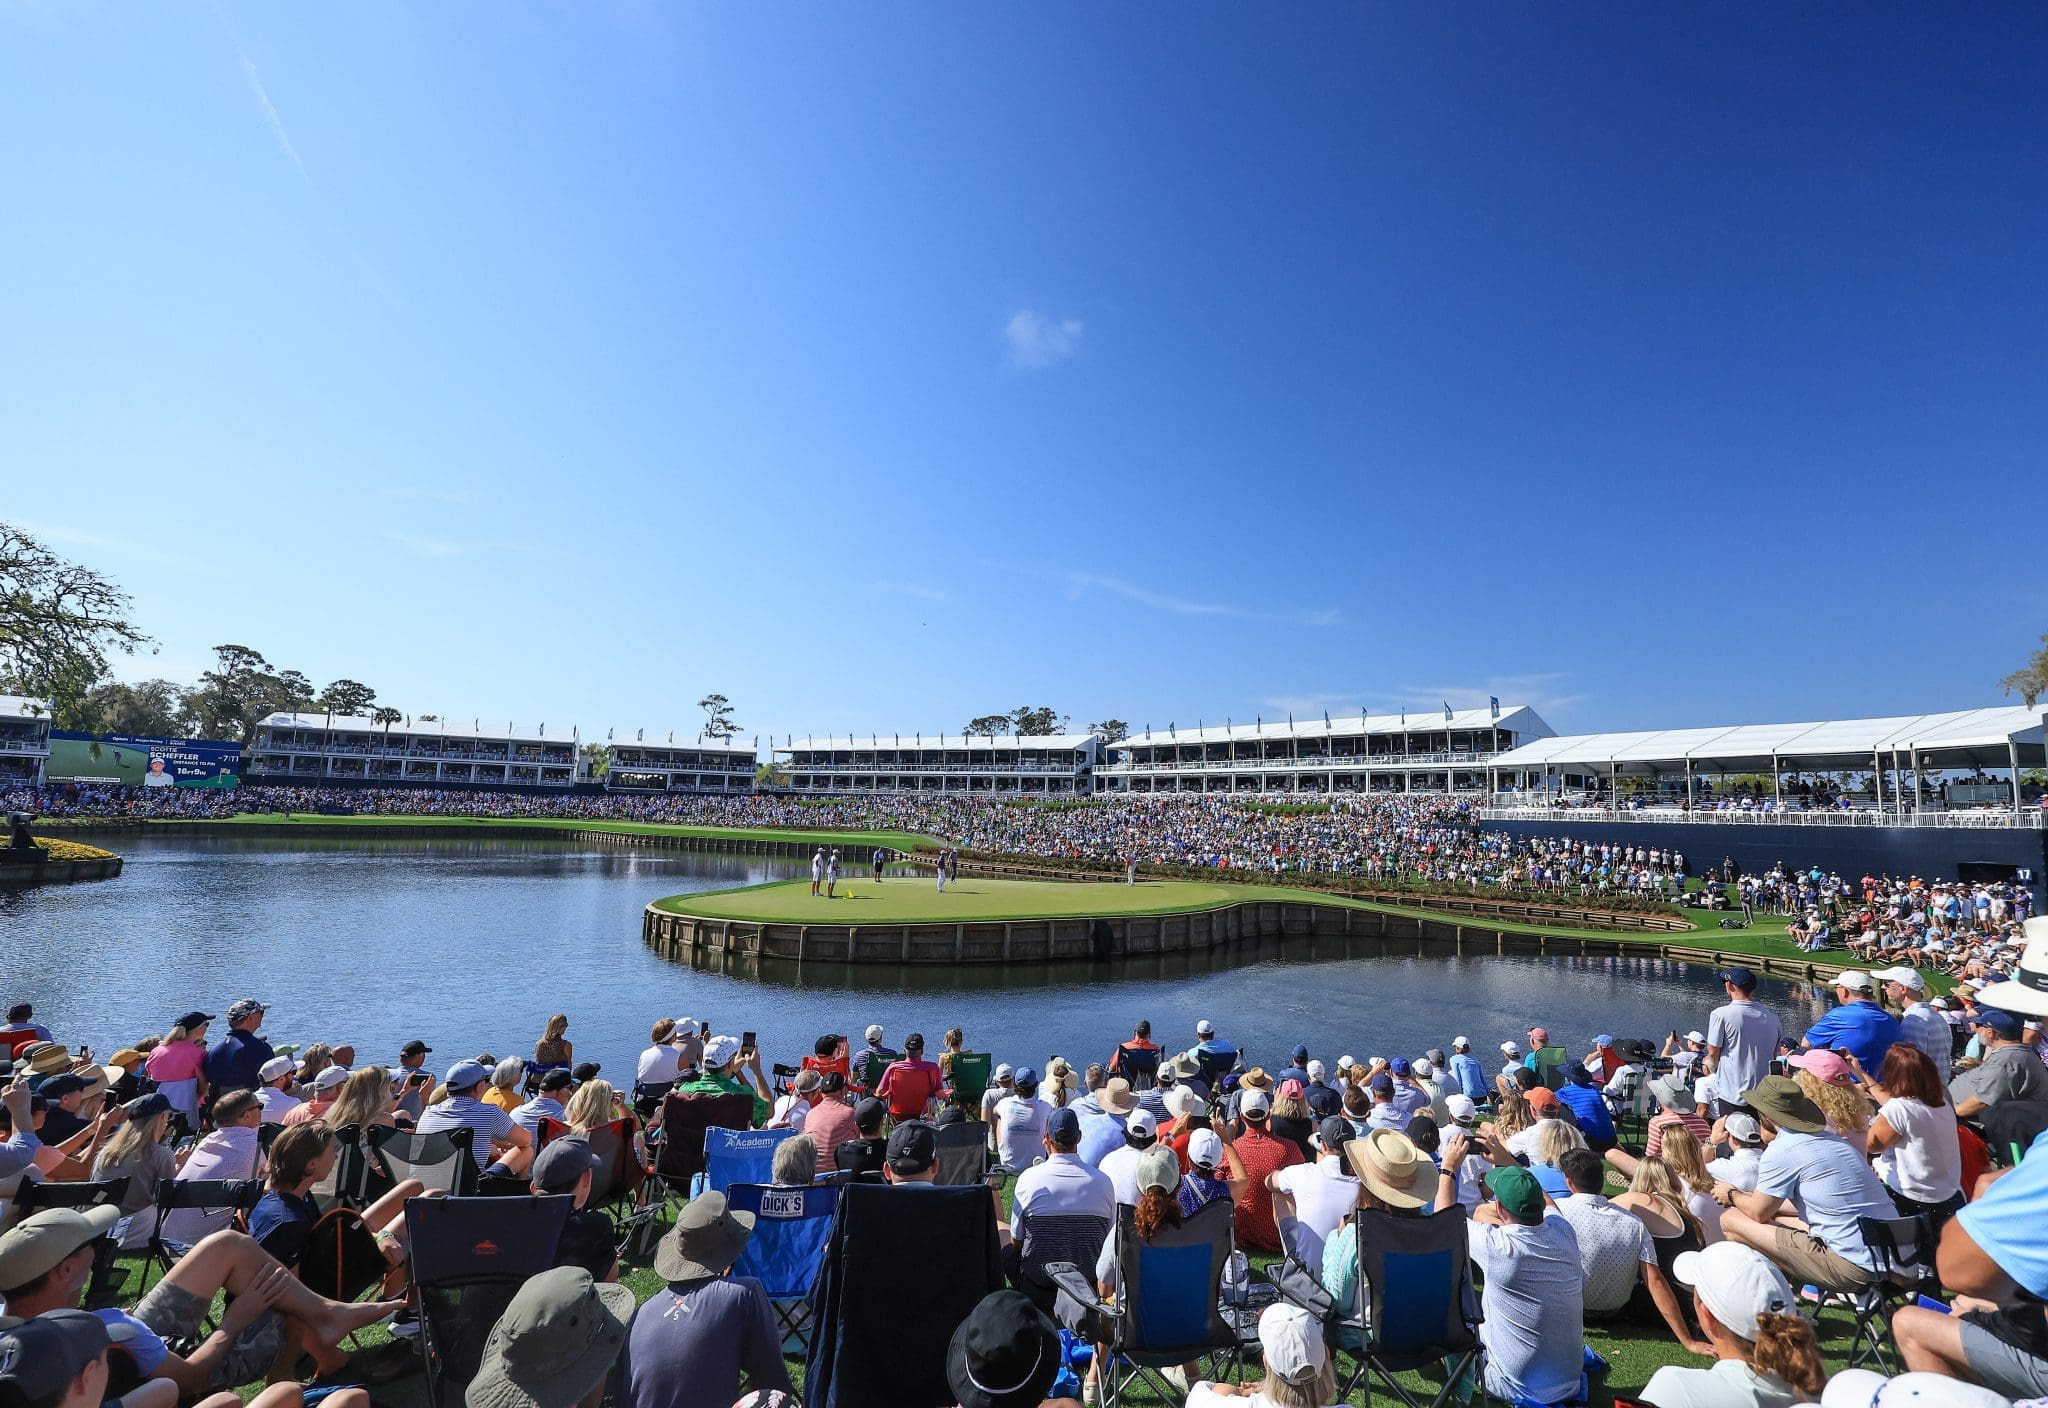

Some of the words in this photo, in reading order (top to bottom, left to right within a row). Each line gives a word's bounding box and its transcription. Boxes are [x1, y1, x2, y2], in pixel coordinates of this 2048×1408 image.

[149, 751, 199, 760] SCHEFFLER
[2017, 869, 2031, 880] 17
[735, 1137, 775, 1147] Academy
[762, 1196, 802, 1212] DICK'S
[673, 1310, 680, 1321] 5
